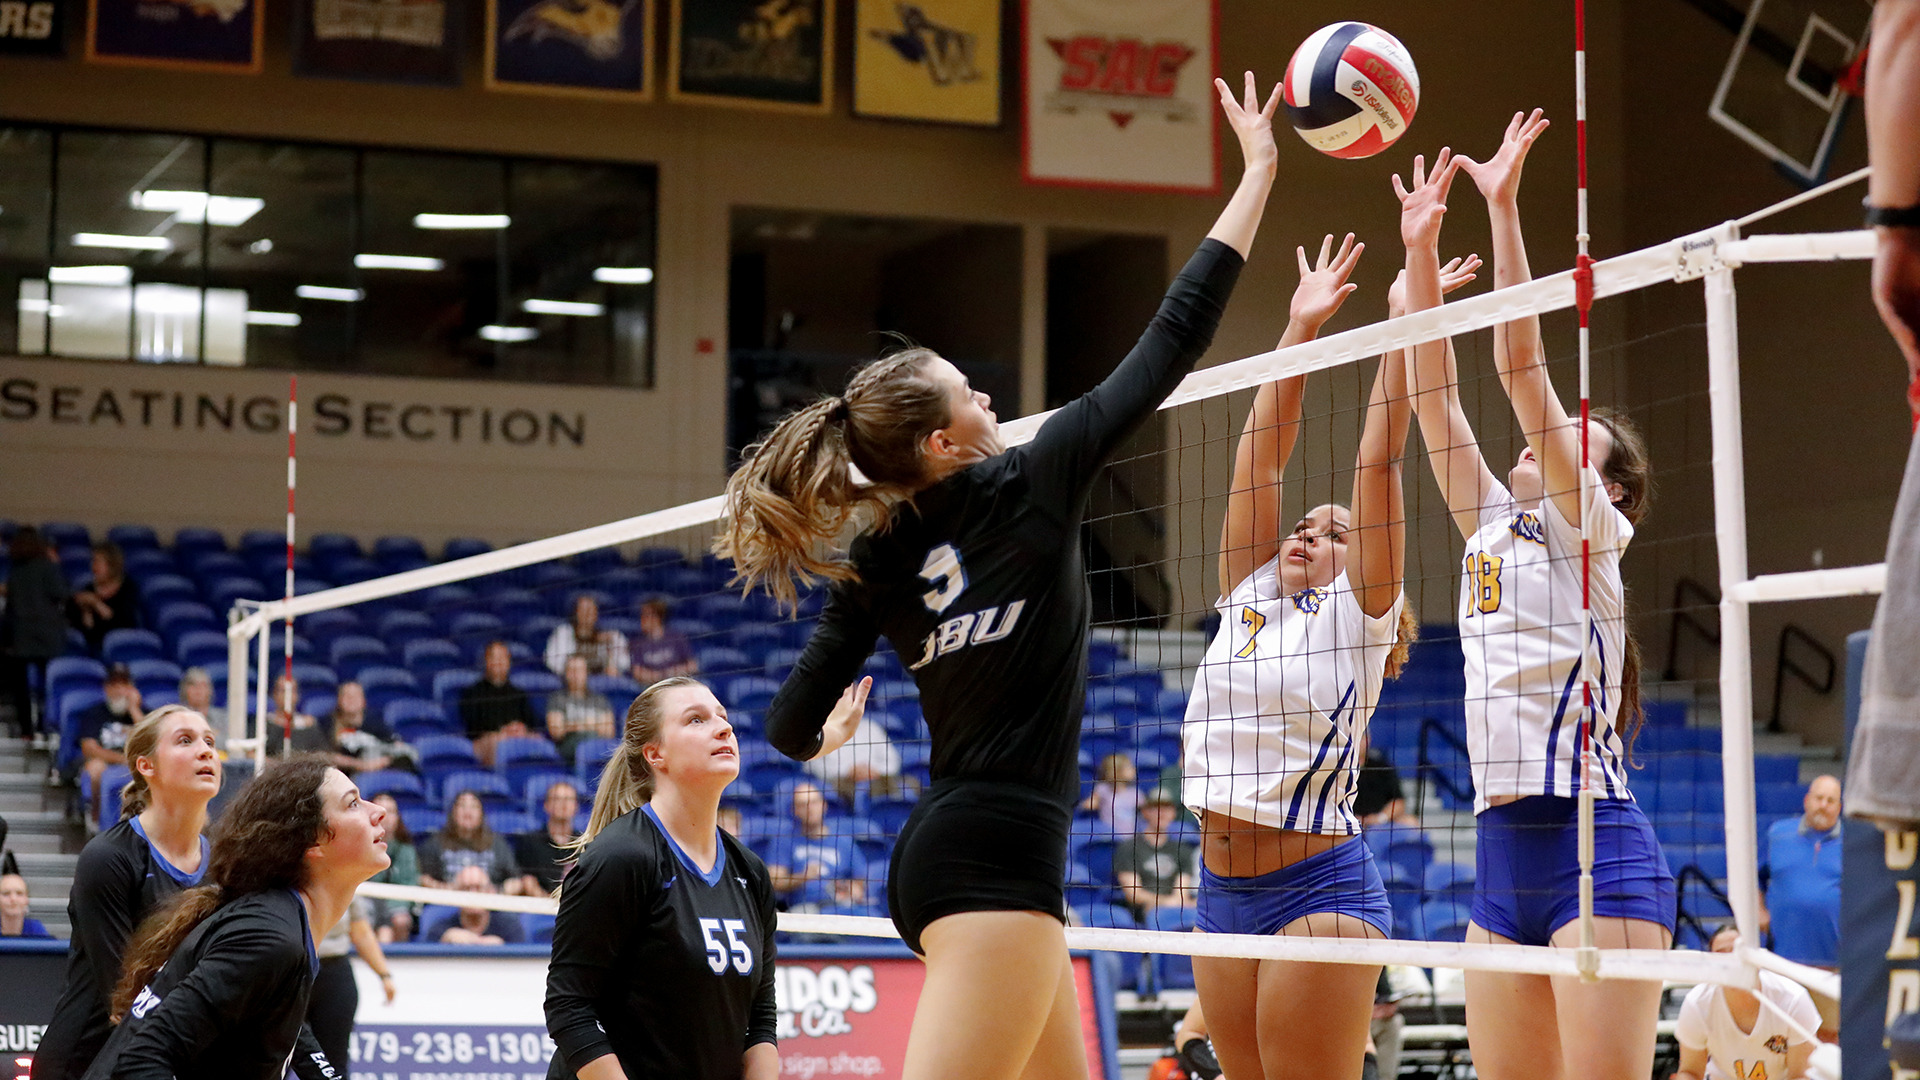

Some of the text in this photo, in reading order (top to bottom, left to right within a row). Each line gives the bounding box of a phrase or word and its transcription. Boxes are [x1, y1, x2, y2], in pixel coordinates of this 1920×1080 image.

[1060, 35, 1183, 97] SAC
[1364, 58, 1414, 114] molten
[1, 377, 587, 447] SEATING SECTION
[1466, 550, 1504, 618] 18
[1234, 605, 1266, 659] 7
[698, 916, 755, 976] 55
